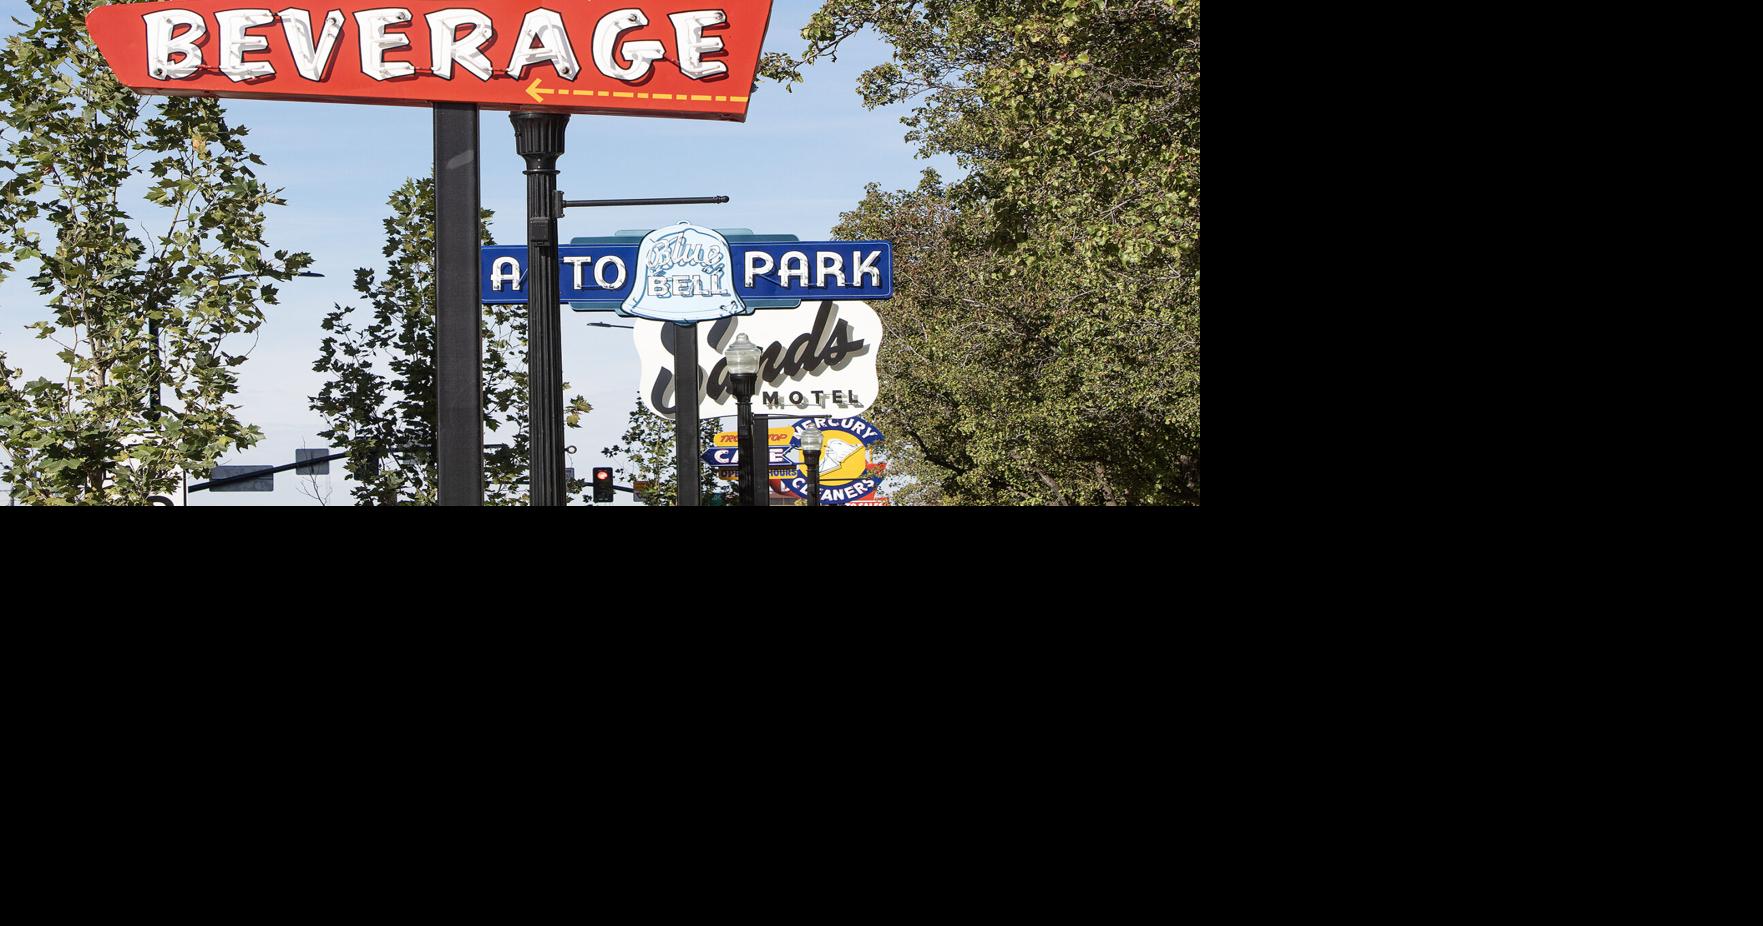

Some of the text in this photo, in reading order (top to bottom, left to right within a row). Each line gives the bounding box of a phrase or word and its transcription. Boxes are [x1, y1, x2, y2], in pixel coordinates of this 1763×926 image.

[142, 6, 730, 82] BEVERAGE
[646, 234, 722, 267] Blue
[490, 250, 882, 291] ATO PARK
[647, 274, 729, 297] BELL
[762, 390, 862, 406] MOTEL
[714, 448, 784, 464] CE
[792, 477, 875, 501] CLANERS
